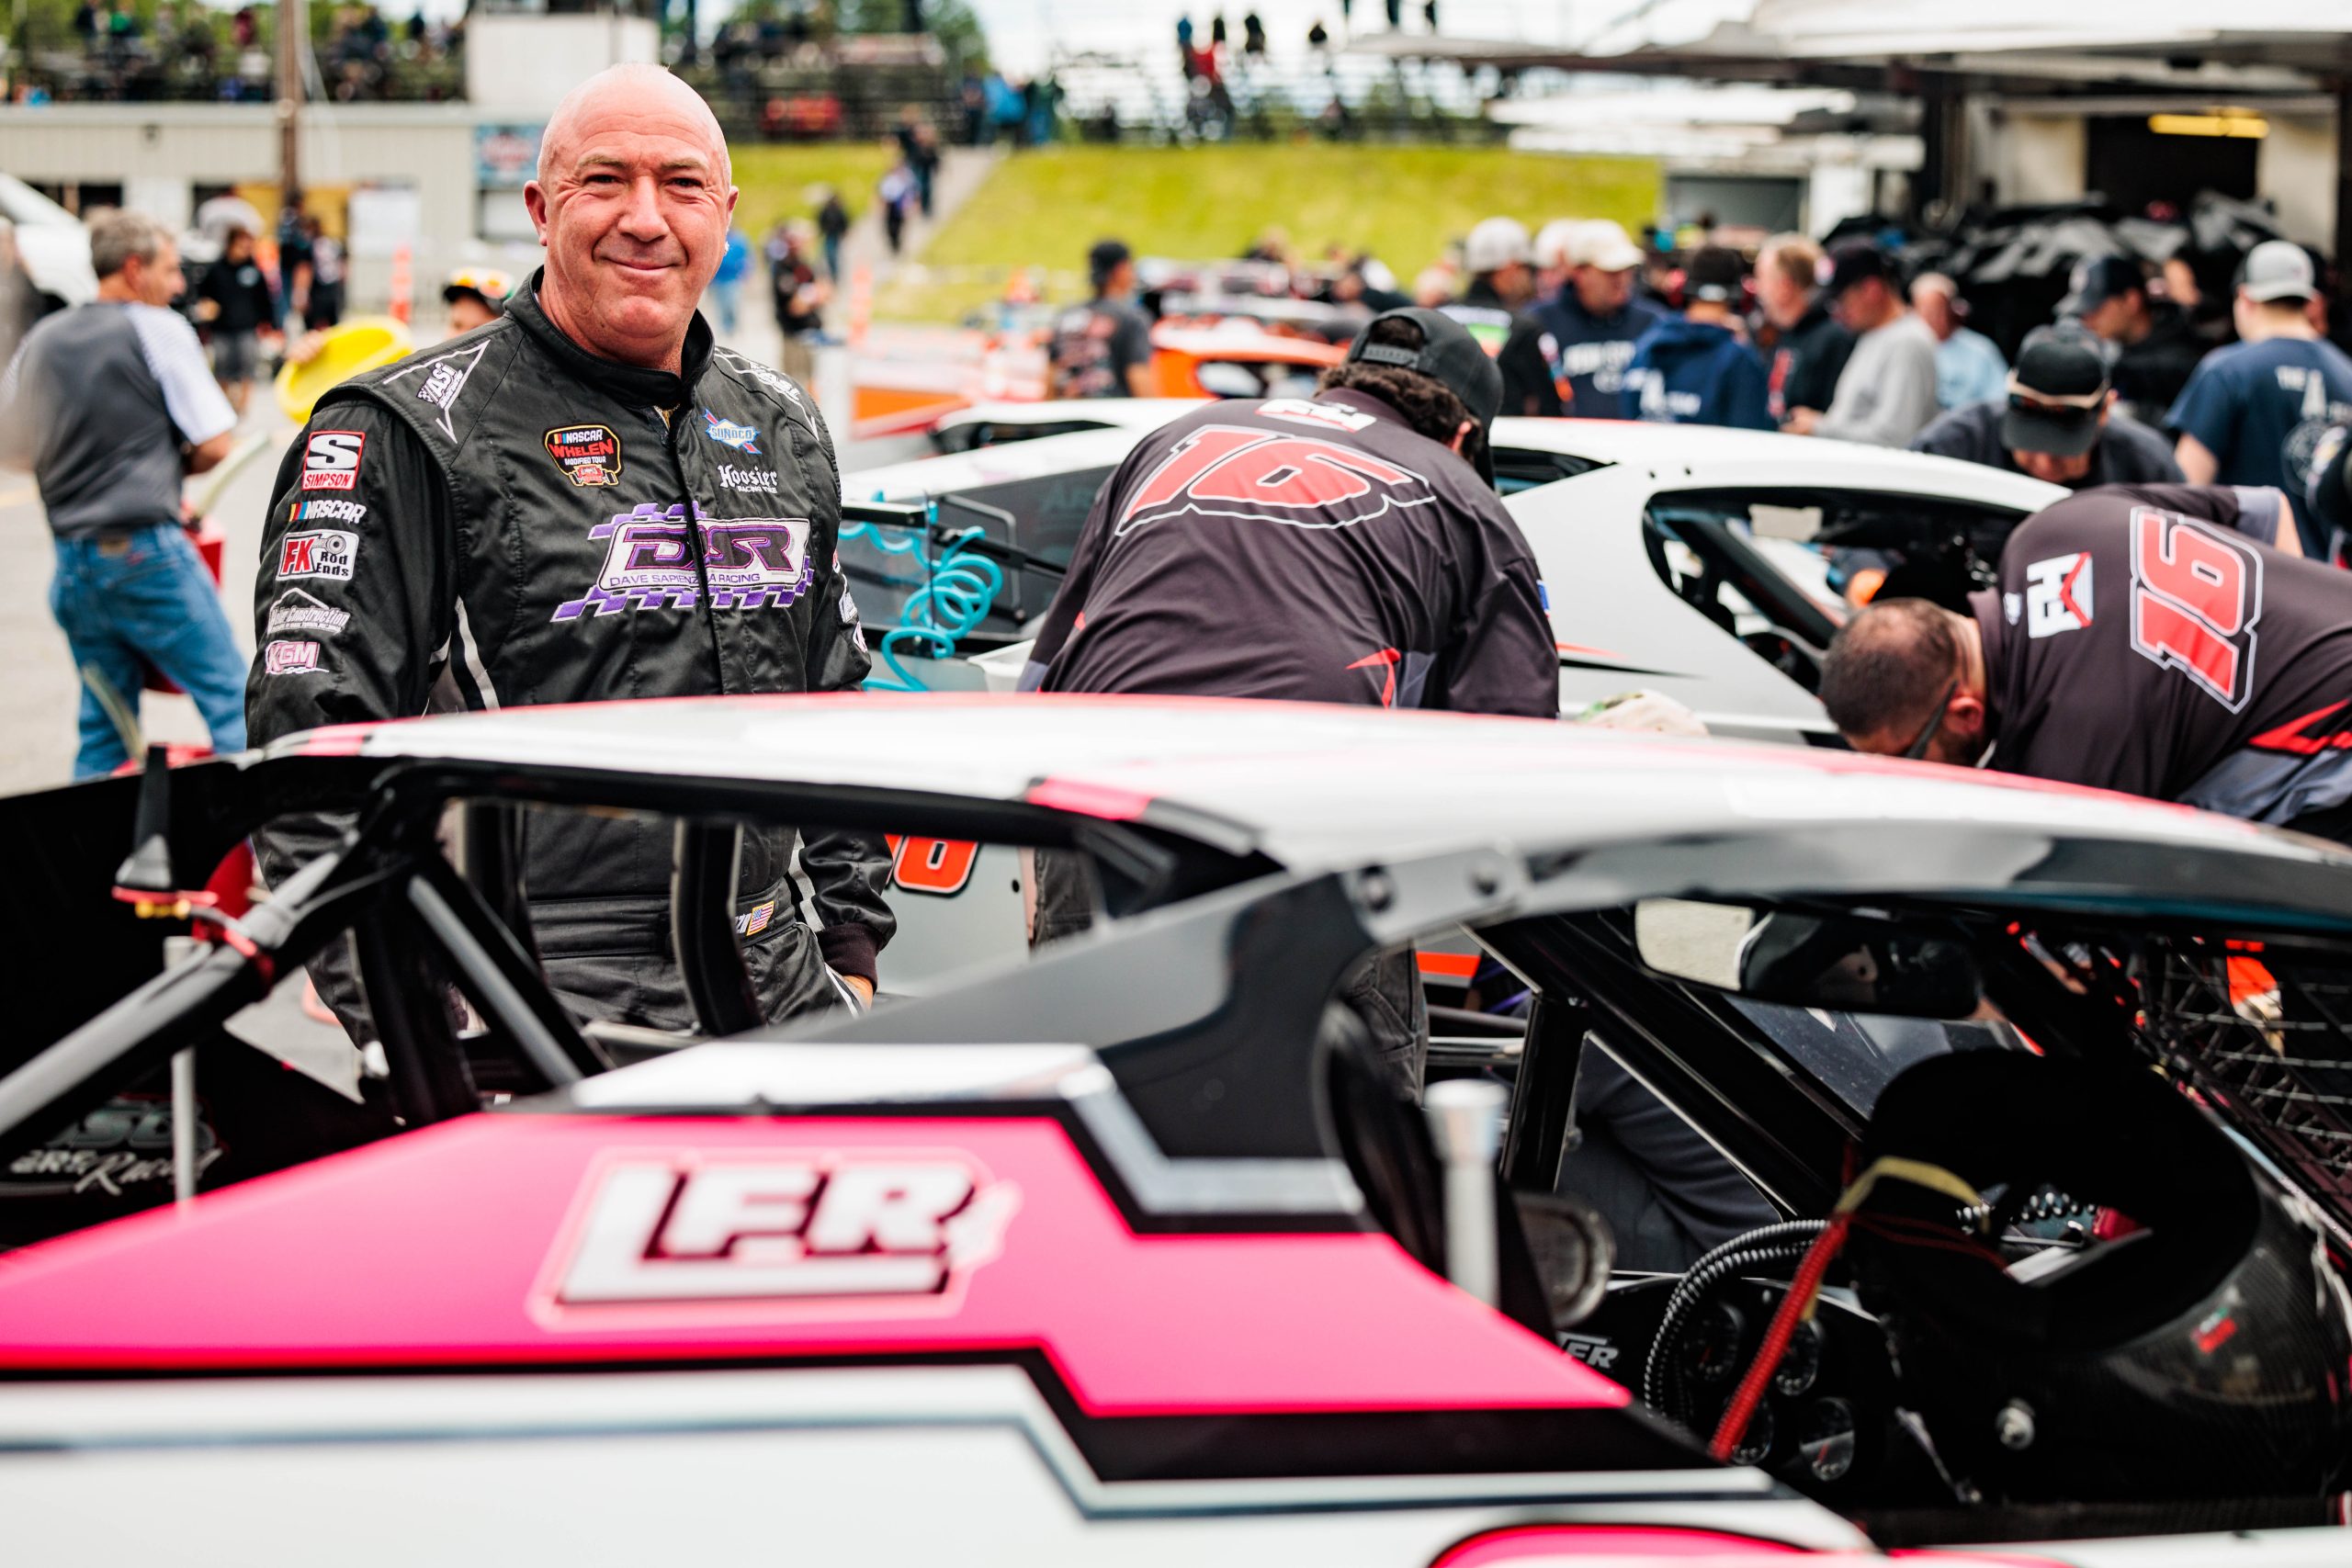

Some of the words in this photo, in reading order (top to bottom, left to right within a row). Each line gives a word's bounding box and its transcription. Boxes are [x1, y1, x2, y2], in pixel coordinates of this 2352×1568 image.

[566, 429, 603, 445] NASCAR
[710, 426, 753, 440] SUNOCO
[307, 434, 362, 469] S
[548, 438, 615, 457] WHELEN
[564, 457, 592, 466] MODIFIED
[592, 456, 606, 464] TOUR
[304, 473, 351, 489] SIMPSON
[718, 464, 778, 489] Hoosier
[1119, 425, 1429, 522] 16
[738, 484, 763, 492] RACING
[304, 500, 368, 525] NASCAR
[281, 536, 316, 575] FK
[321, 551, 349, 566] Rod
[316, 562, 350, 577] Ends
[609, 574, 648, 587] DAVE
[651, 573, 716, 584] SAPIENZA
[718, 573, 761, 583] RACING
[288, 606, 351, 628] Construction
[2132, 507, 2256, 708] 16
[266, 642, 319, 673] KGM
[557, 1161, 976, 1304] LFR
